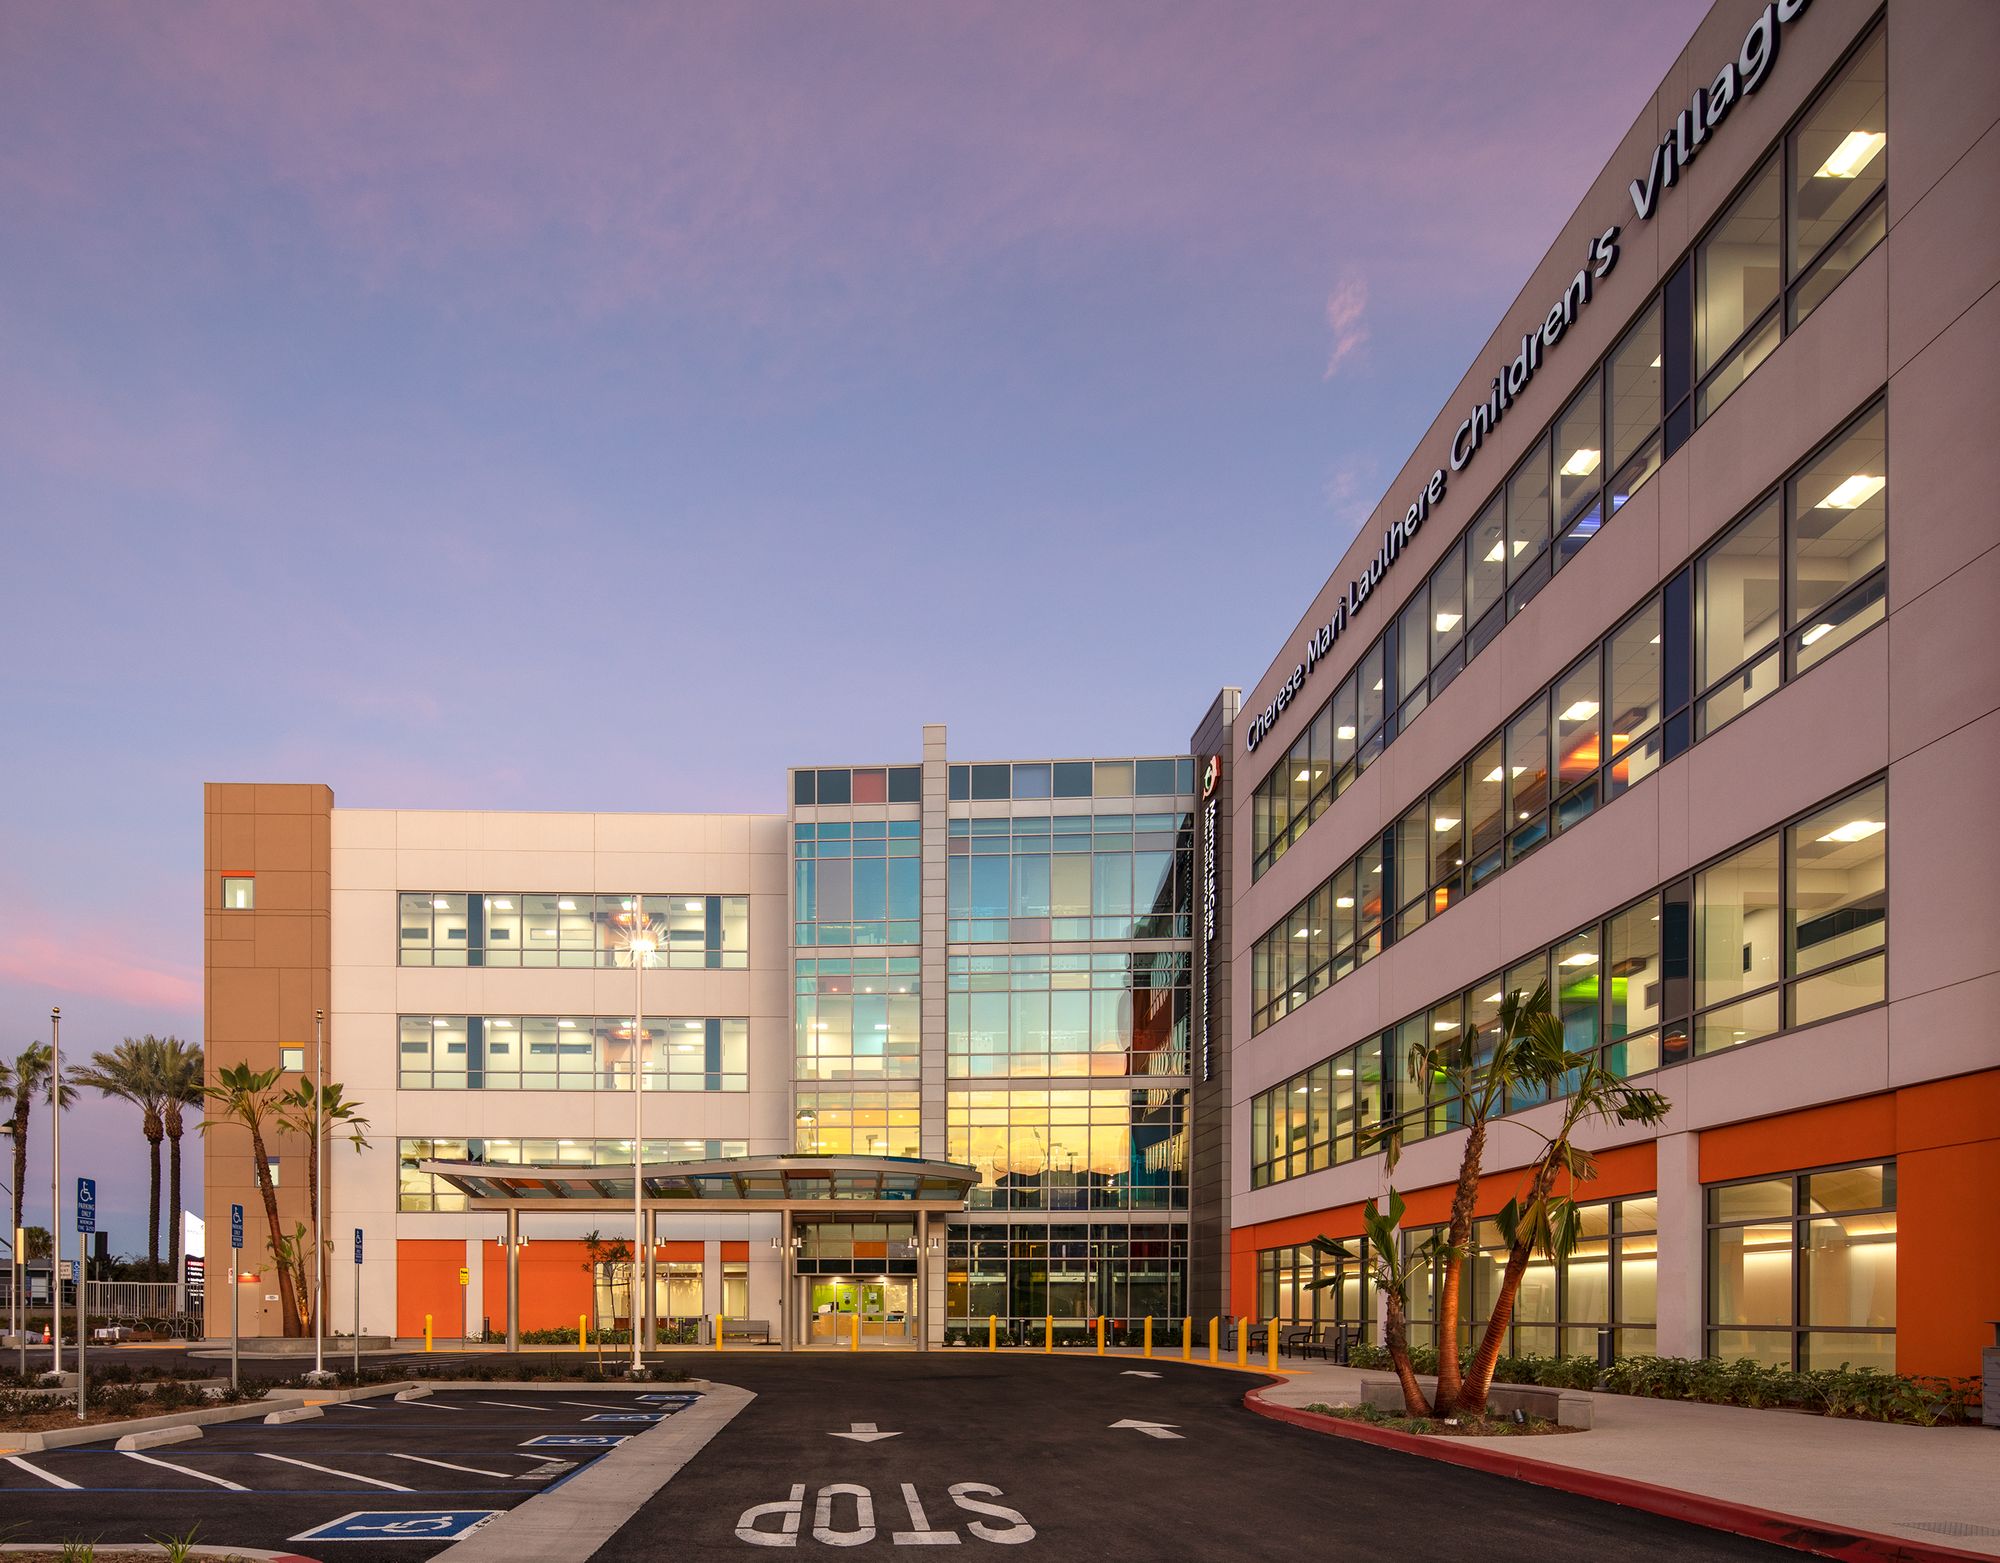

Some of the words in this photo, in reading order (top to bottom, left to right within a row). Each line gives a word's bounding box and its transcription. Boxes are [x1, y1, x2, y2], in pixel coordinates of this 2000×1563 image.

[1247, 664, 1305, 752] Cherese
[1307, 597, 1347, 673] Mari
[1348, 469, 1447, 616] Laulhere
[1450, 226, 1620, 471] Children's
[1208, 799, 1216, 941] MemorialCare
[735, 1482, 1036, 1547] STOP
